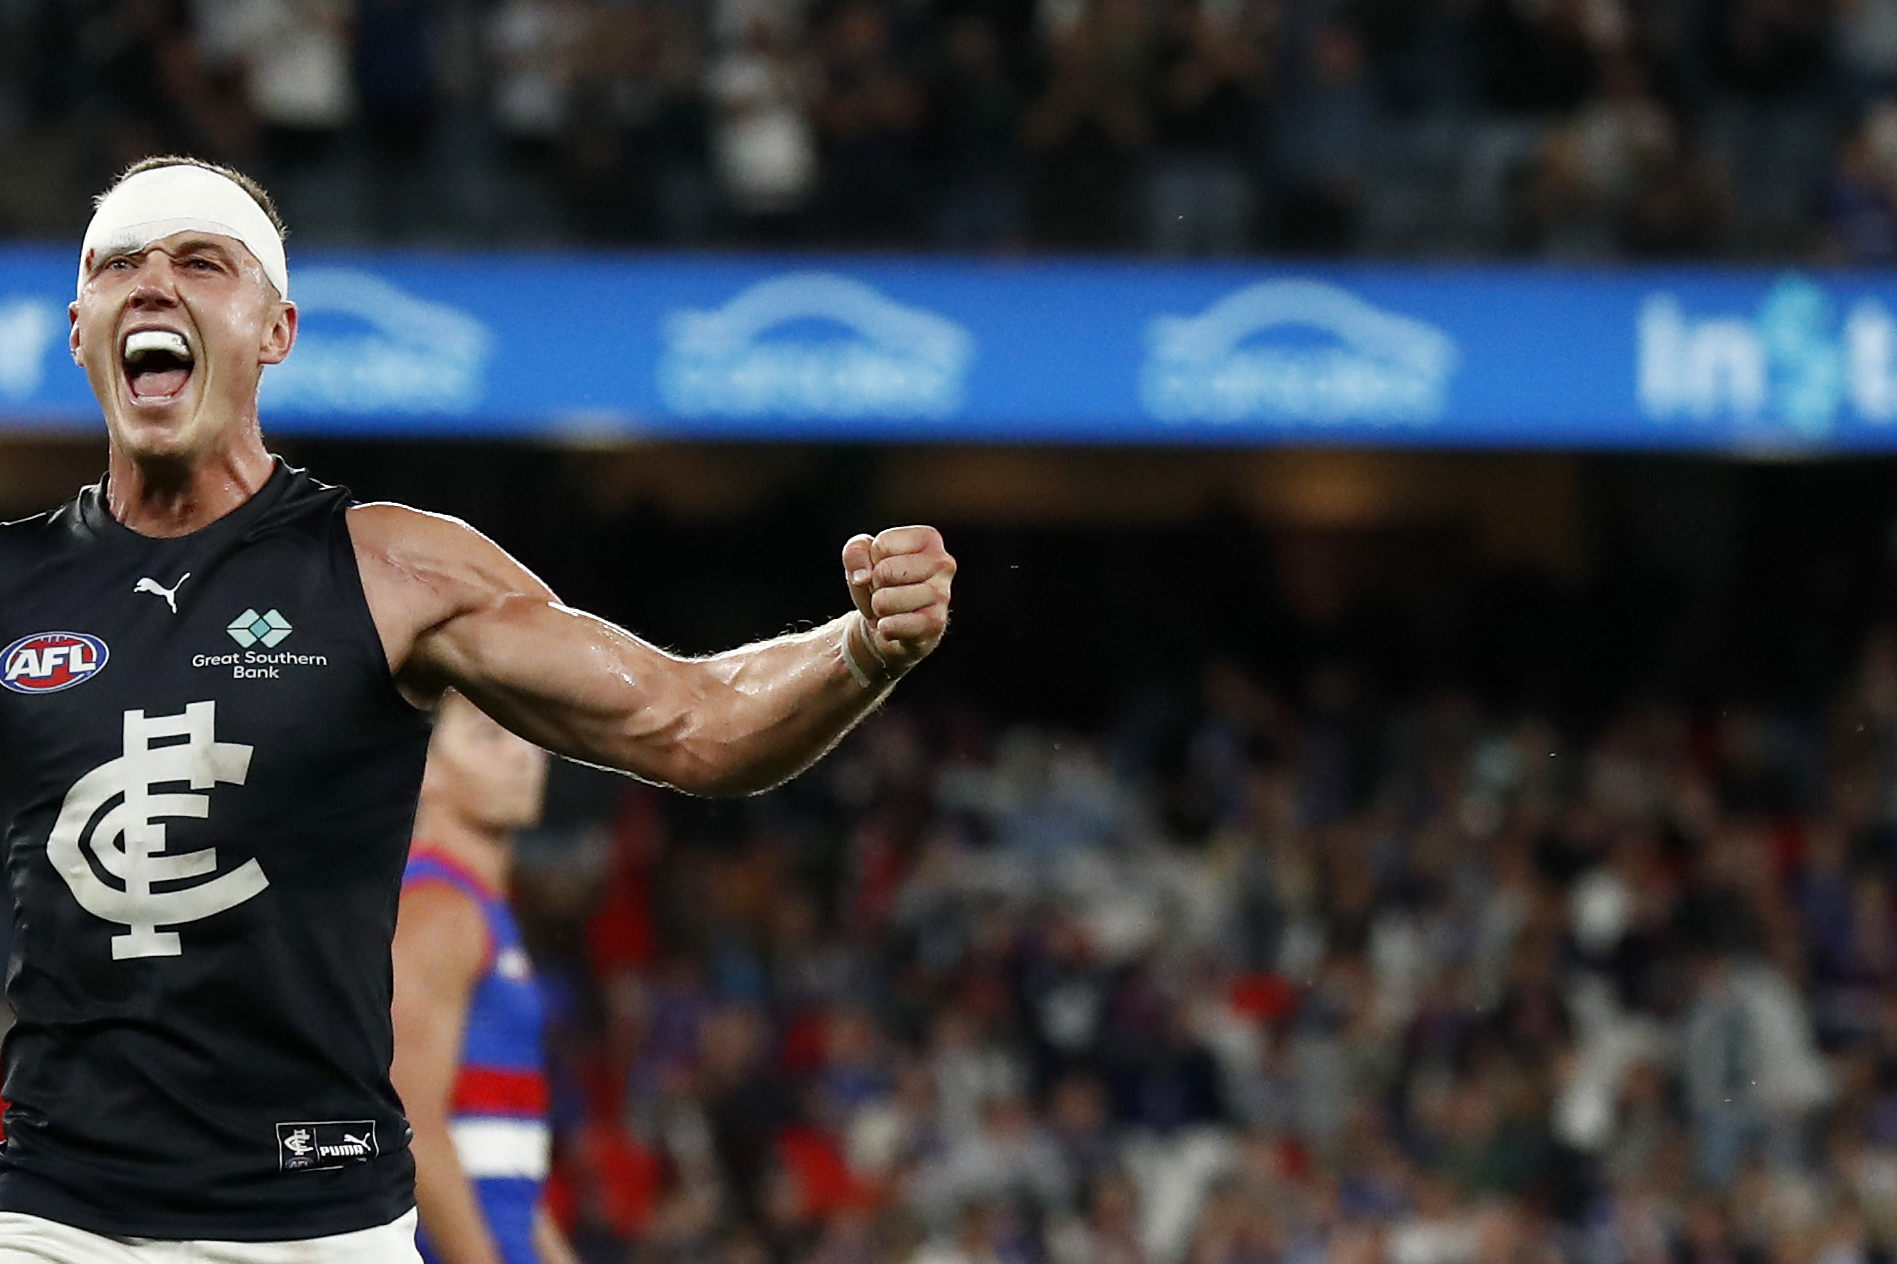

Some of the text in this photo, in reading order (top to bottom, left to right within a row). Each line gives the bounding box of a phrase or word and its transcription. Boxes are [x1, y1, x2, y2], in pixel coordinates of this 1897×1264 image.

[4, 643, 97, 681] AFL
[192, 650, 328, 668] Great Southern
[233, 665, 280, 679] Bank
[319, 1144, 364, 1157] PUMA
